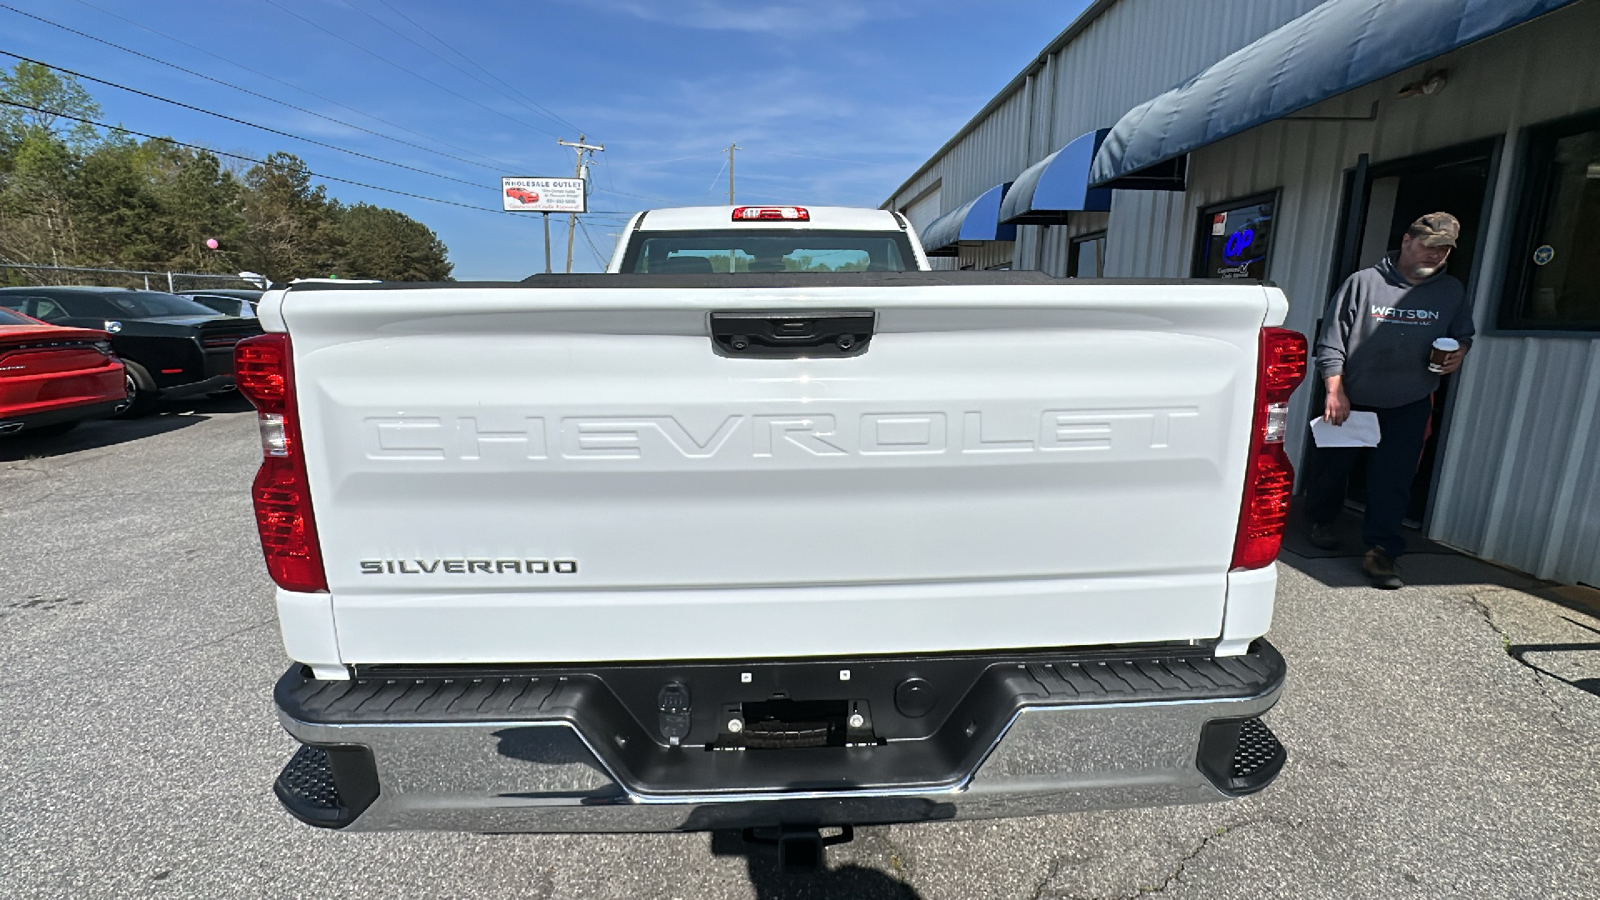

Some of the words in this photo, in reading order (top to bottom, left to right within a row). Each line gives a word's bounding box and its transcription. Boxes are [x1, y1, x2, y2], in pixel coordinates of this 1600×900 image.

[1371, 305, 1439, 320] WATSON
[363, 406, 1199, 461] CHEVROLET
[360, 558, 578, 575] SILVERADO
